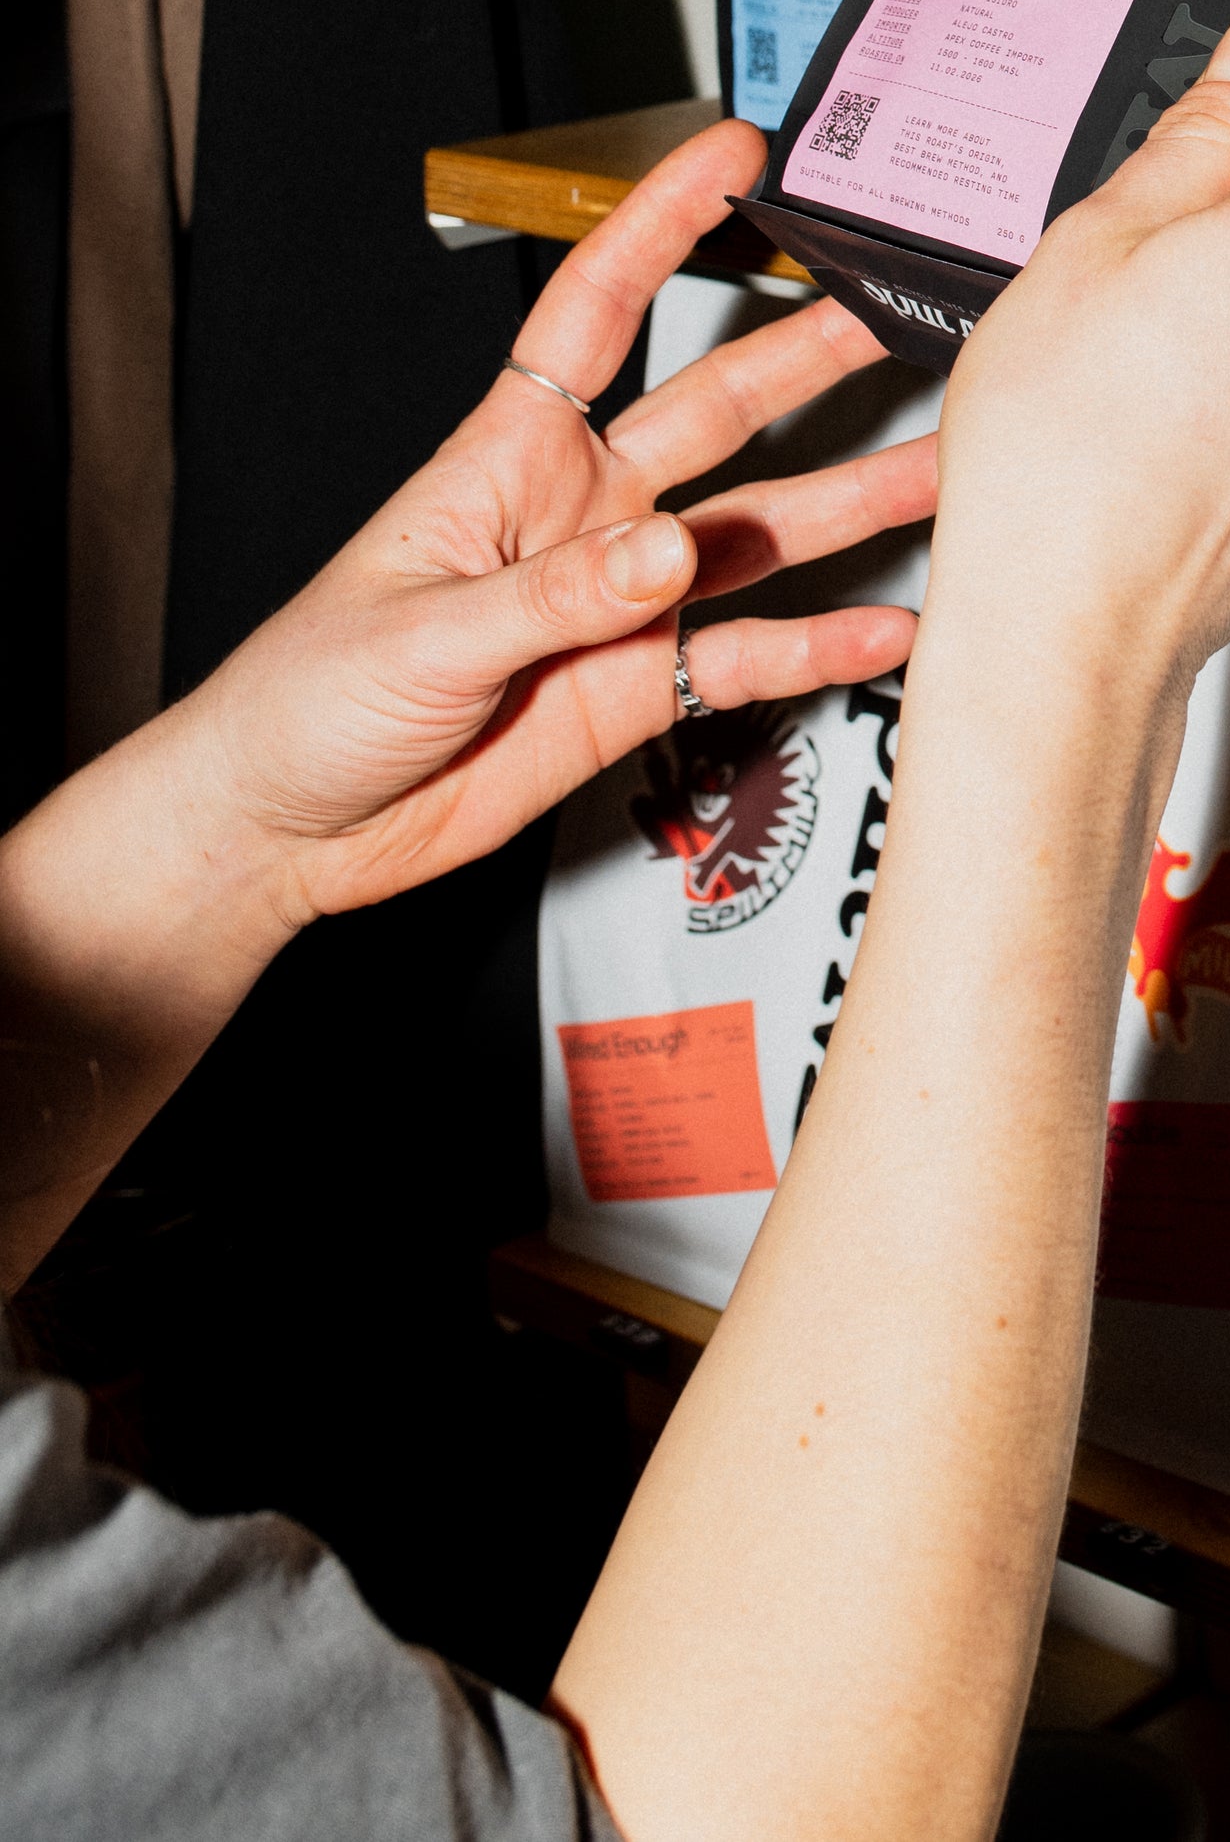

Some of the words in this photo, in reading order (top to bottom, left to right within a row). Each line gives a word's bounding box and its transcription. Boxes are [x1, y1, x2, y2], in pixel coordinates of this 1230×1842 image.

[959, 5, 993, 19] NATURAL
[952, 20, 977, 31] ALEJO
[982, 26, 1015, 41] CASTRO
[945, 34, 965, 45] APEX
[970, 39, 1001, 55] COFFEE
[1006, 49, 1044, 66] IMPORTS
[889, 156, 948, 181] RECOMMENDED
[954, 177, 992, 194] RESTING
[999, 189, 1020, 203] TIME
[800, 167, 841, 186] SUITABLE
[847, 181, 863, 193] FOR
[869, 188, 883, 199] ALL
[890, 194, 925, 213] BREWING
[931, 207, 970, 226] METHODS
[997, 228, 1014, 241] 250
[1019, 234, 1025, 244] G
